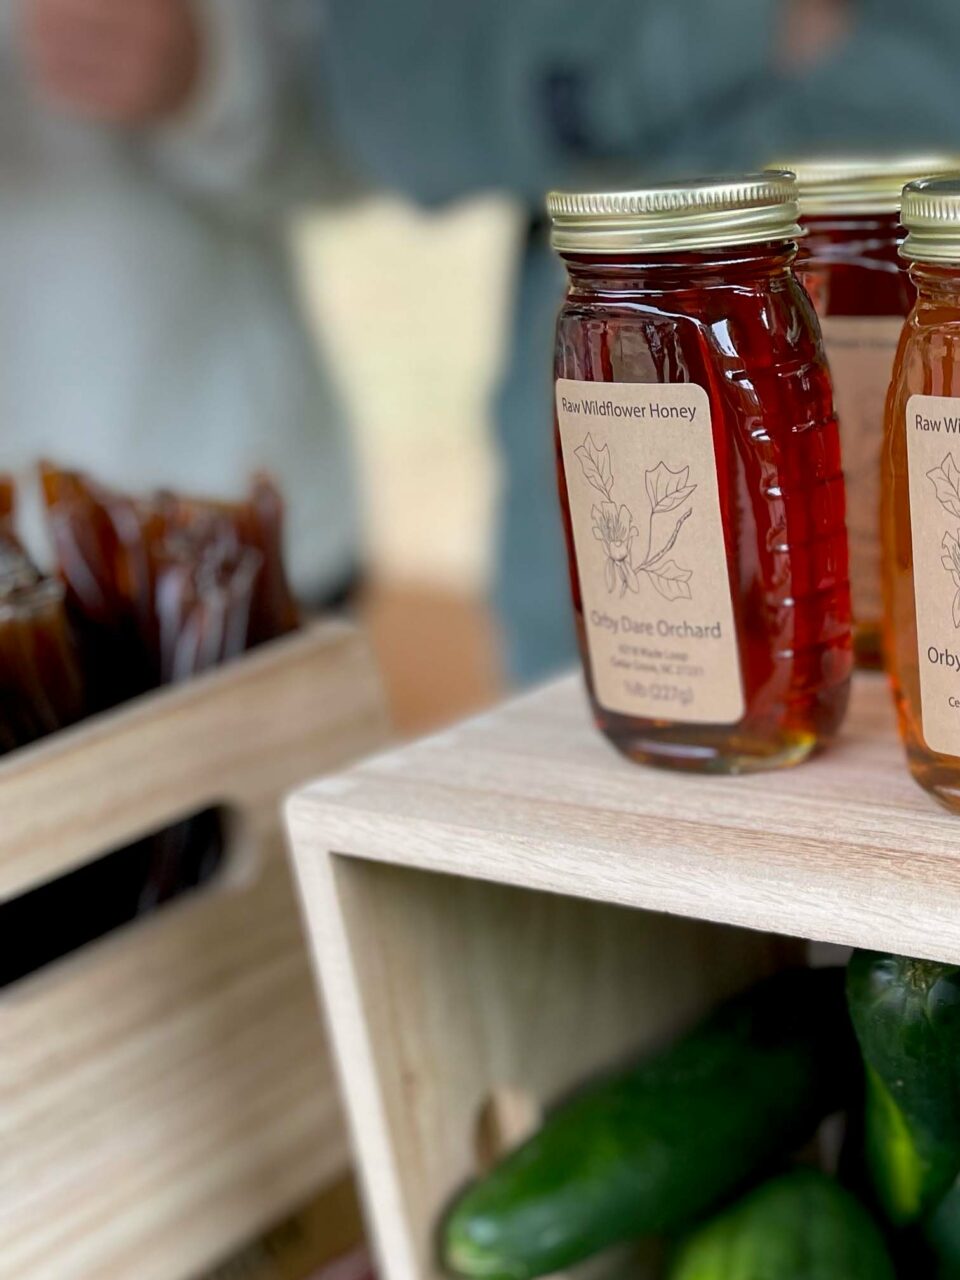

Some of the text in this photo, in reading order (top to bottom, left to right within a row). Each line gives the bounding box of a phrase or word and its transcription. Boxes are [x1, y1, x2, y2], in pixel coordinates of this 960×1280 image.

[562, 398, 696, 422] Raw Wildflower Honey
[915, 414, 941, 433] Raw
[621, 615, 654, 636] Dare
[657, 619, 721, 638] Orchard
